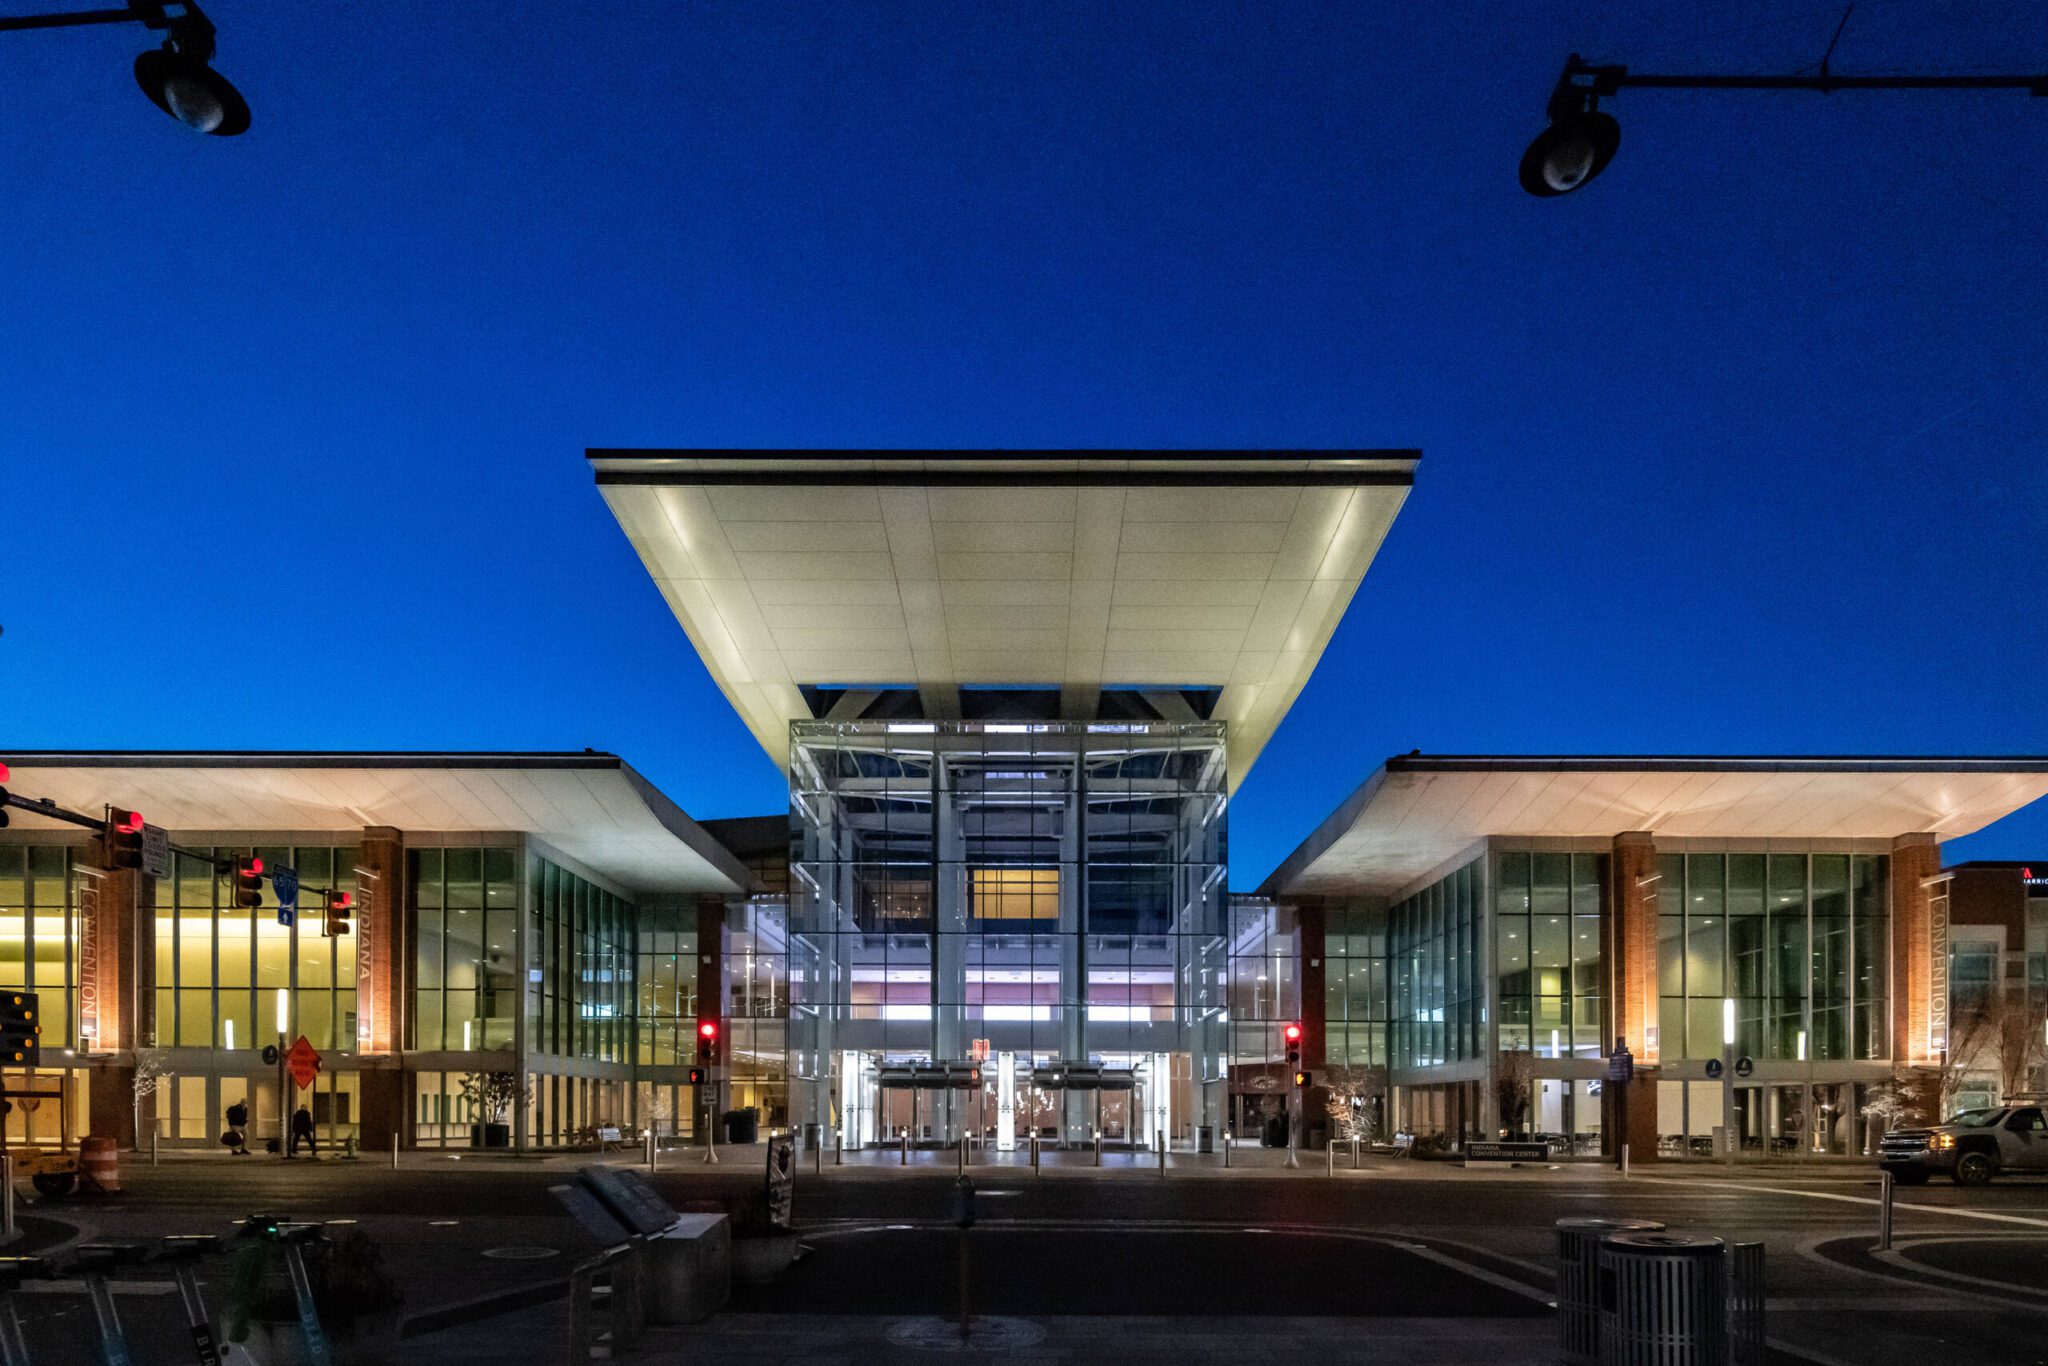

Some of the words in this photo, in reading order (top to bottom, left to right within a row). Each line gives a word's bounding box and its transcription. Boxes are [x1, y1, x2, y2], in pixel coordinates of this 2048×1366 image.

[81, 892, 96, 1013] CONVENTION
[360, 893, 371, 980] INDIANA
[1932, 901, 1946, 1026] CONVENTION
[196, 1335, 217, 1366] BIR
[302, 1312, 323, 1354] BIRD
